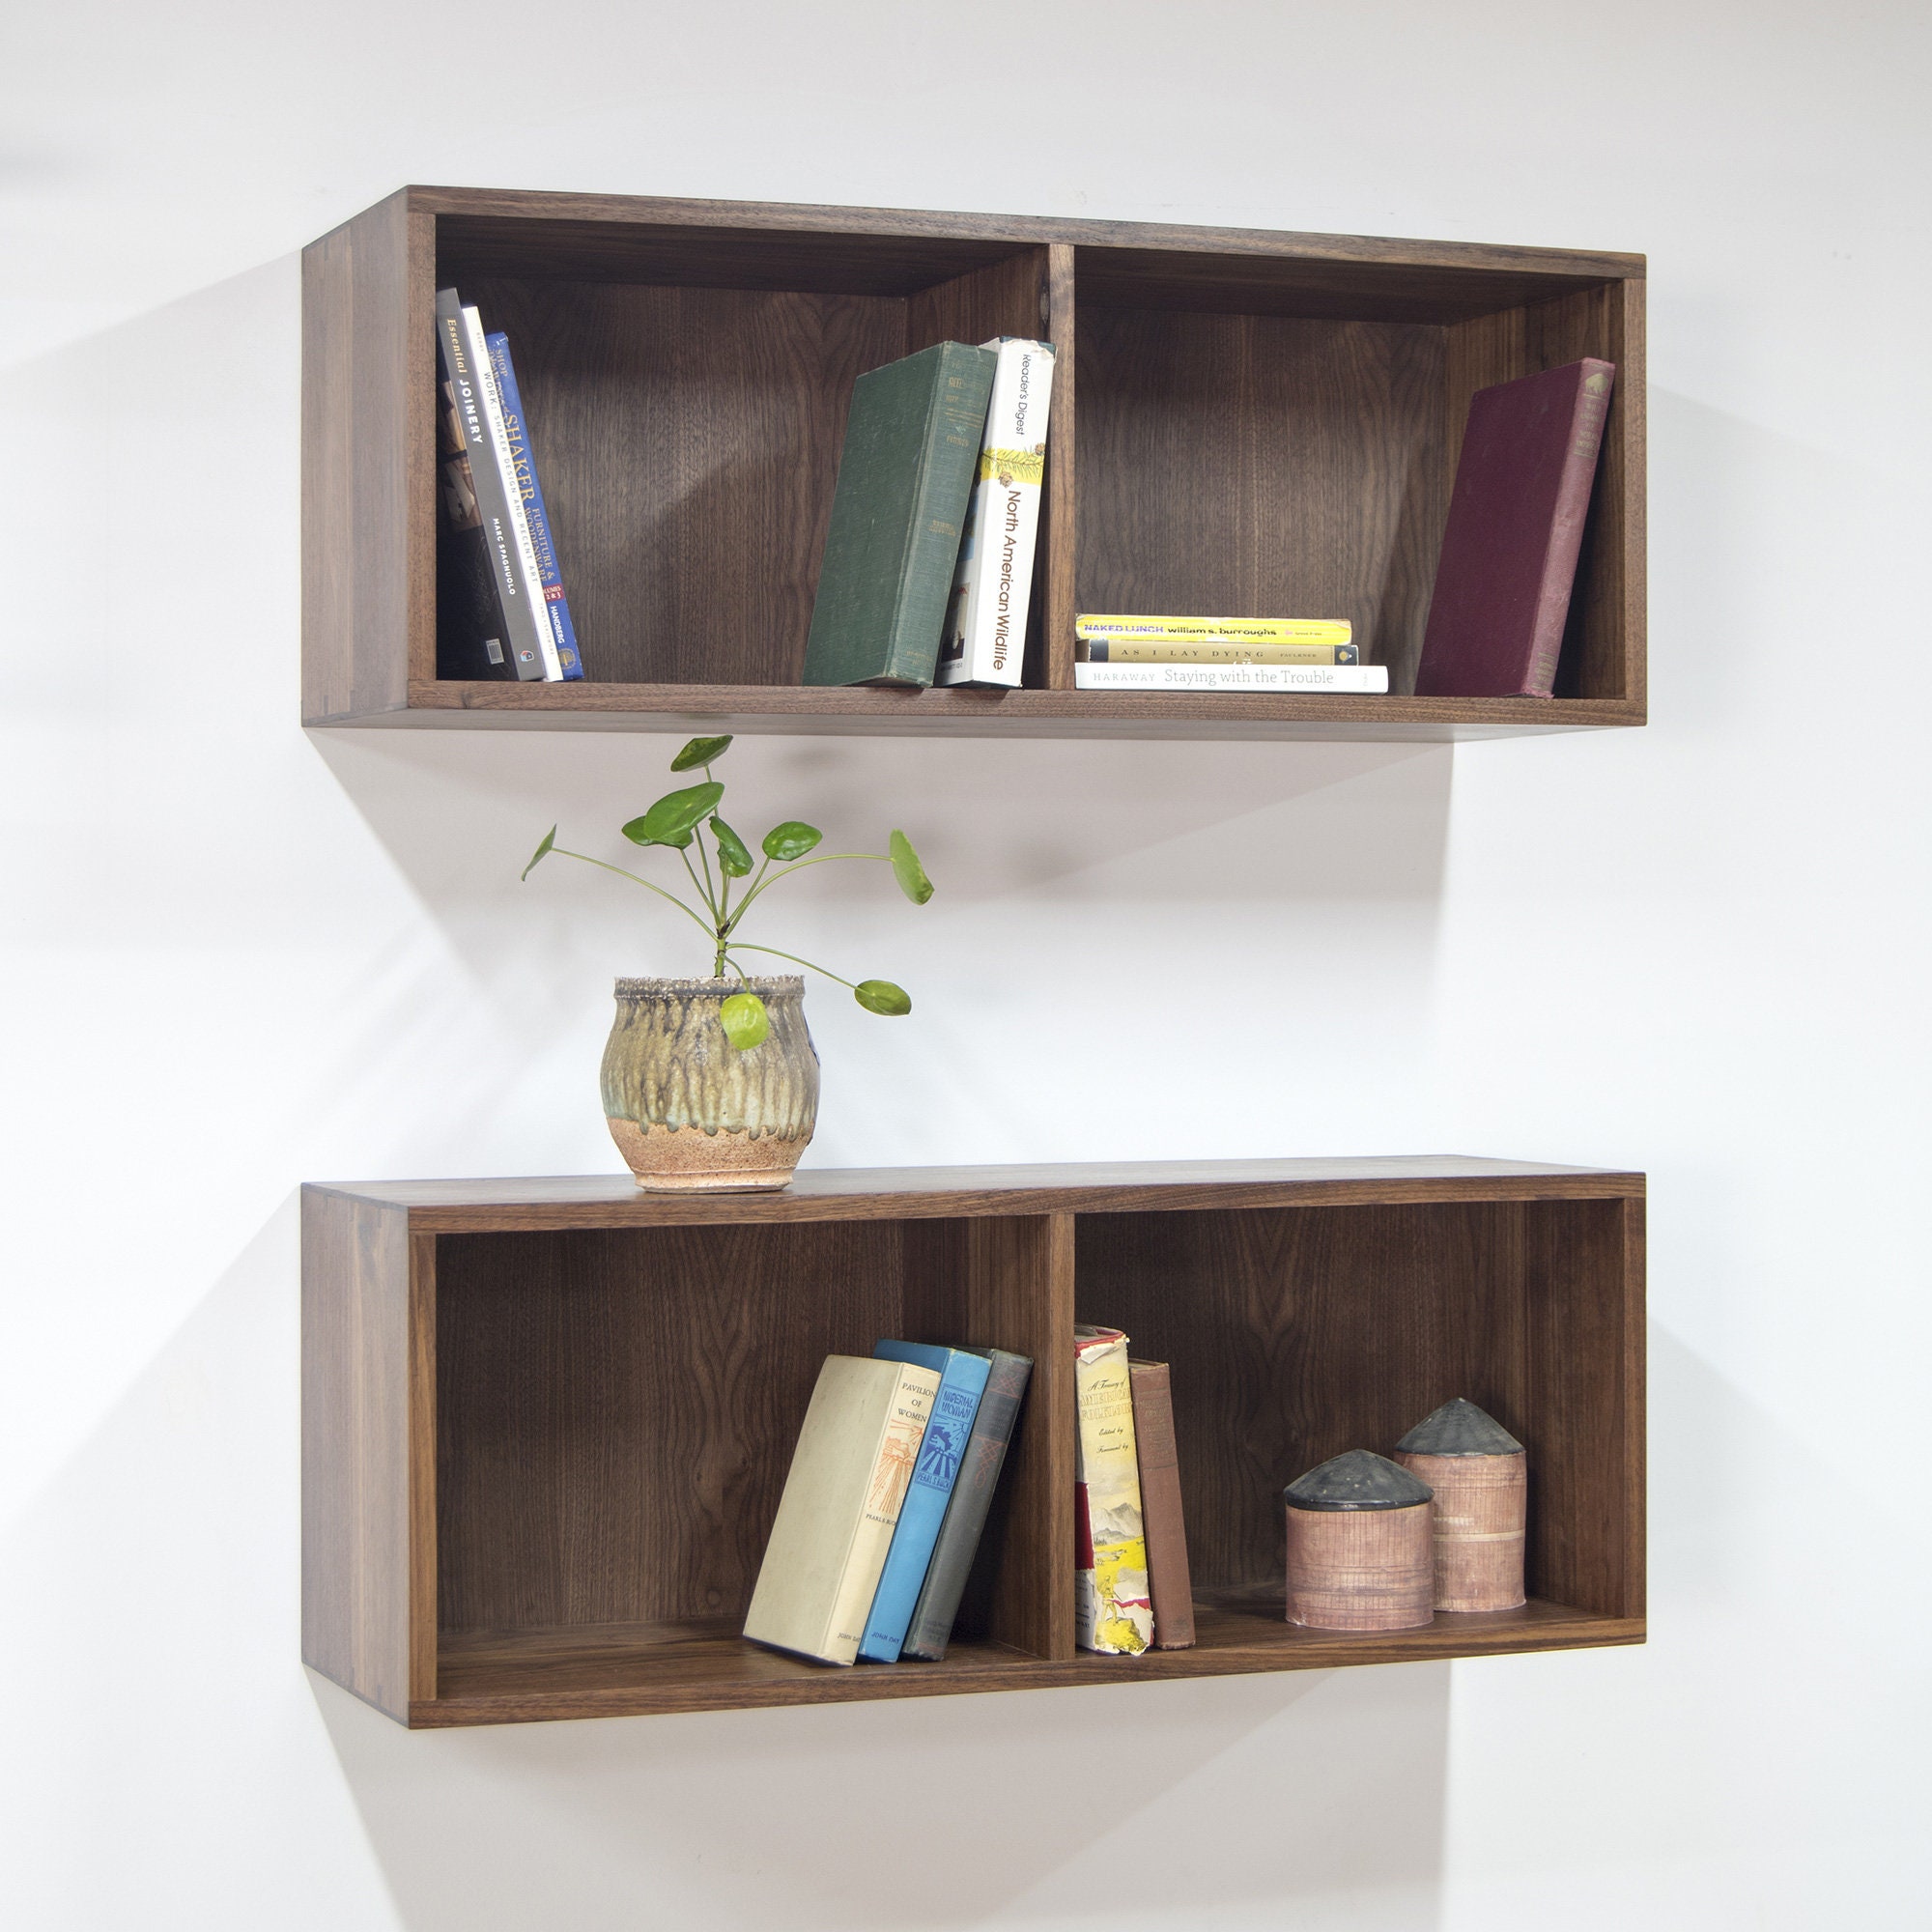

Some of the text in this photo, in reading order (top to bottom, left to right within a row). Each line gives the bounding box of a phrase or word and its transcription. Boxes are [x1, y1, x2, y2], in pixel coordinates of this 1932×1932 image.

[495, 349, 509, 377] SHOP
[446, 319, 483, 443] Essential JOINERY
[1015, 354, 1032, 436] Reader's Digest
[504, 413, 535, 506] SHAKER
[484, 371, 538, 582] WORK: SHAKER DESIGN AND RECENT ART
[493, 517, 516, 596] MARC SPAGNUOLO
[525, 507, 548, 582] WOODENWARE
[531, 507, 555, 580] FURNITURE &
[993, 490, 1021, 670] North American Wildlife
[550, 606, 565, 644] HANDBERG
[1084, 624, 1123, 633] NAKED
[1124, 625, 1164, 634] LUNCH
[1219, 628, 1277, 637] burroughs
[1093, 668, 1334, 687] HARAWAY Staying with the Trouble
[901, 1382, 937, 1398] PAVILION
[911, 1399, 923, 1407] OF
[943, 1391, 974, 1408] IMPERIAL
[898, 1407, 927, 1422] WOMEN
[941, 1402, 971, 1419] WOMAN
[866, 1513, 882, 1522] PEARL
[871, 1632, 888, 1640] JOHN
